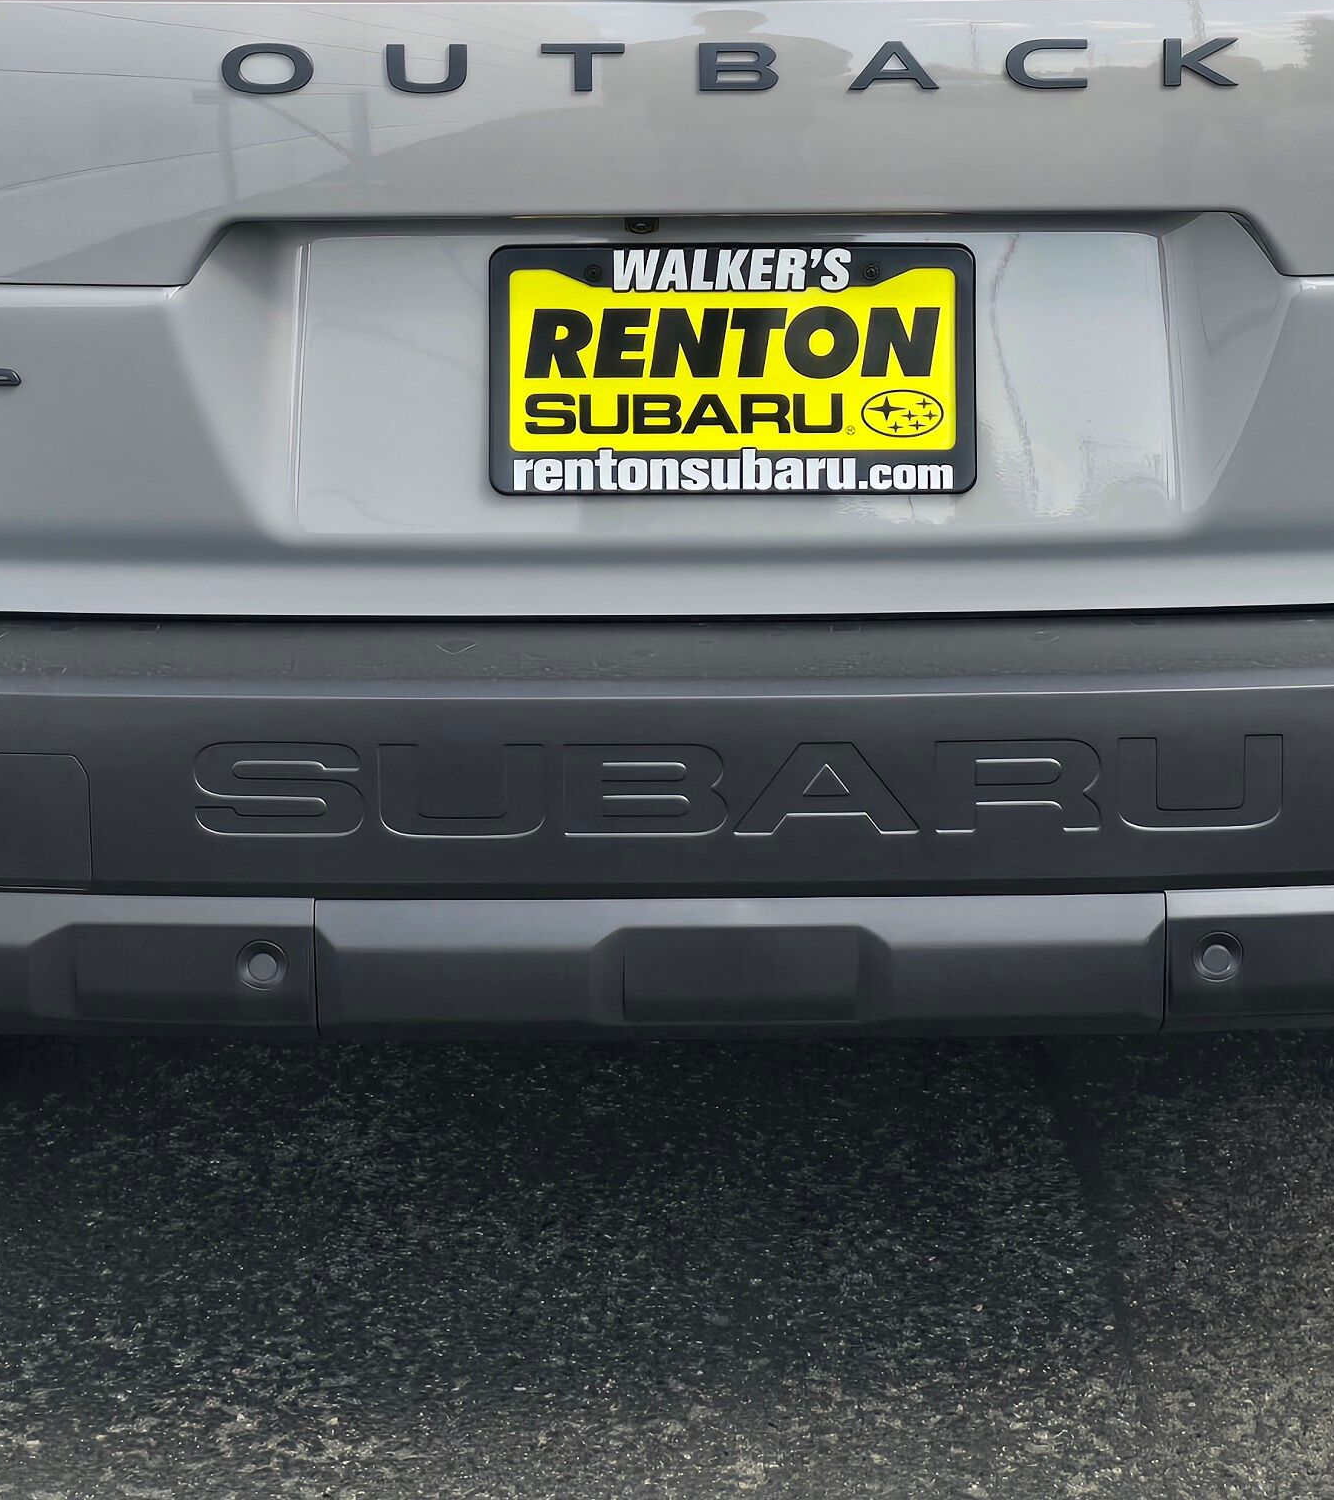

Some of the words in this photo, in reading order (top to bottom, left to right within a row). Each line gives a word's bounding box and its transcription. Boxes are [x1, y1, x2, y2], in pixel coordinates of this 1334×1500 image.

[220, 37, 1240, 93] OUTBACK
[613, 248, 851, 291] WALKER'S
[524, 306, 940, 379] RENTON
[524, 392, 843, 434] SUBARU
[512, 448, 953, 492] rentonsubaru.com
[193, 734, 1284, 838] SUBARU
